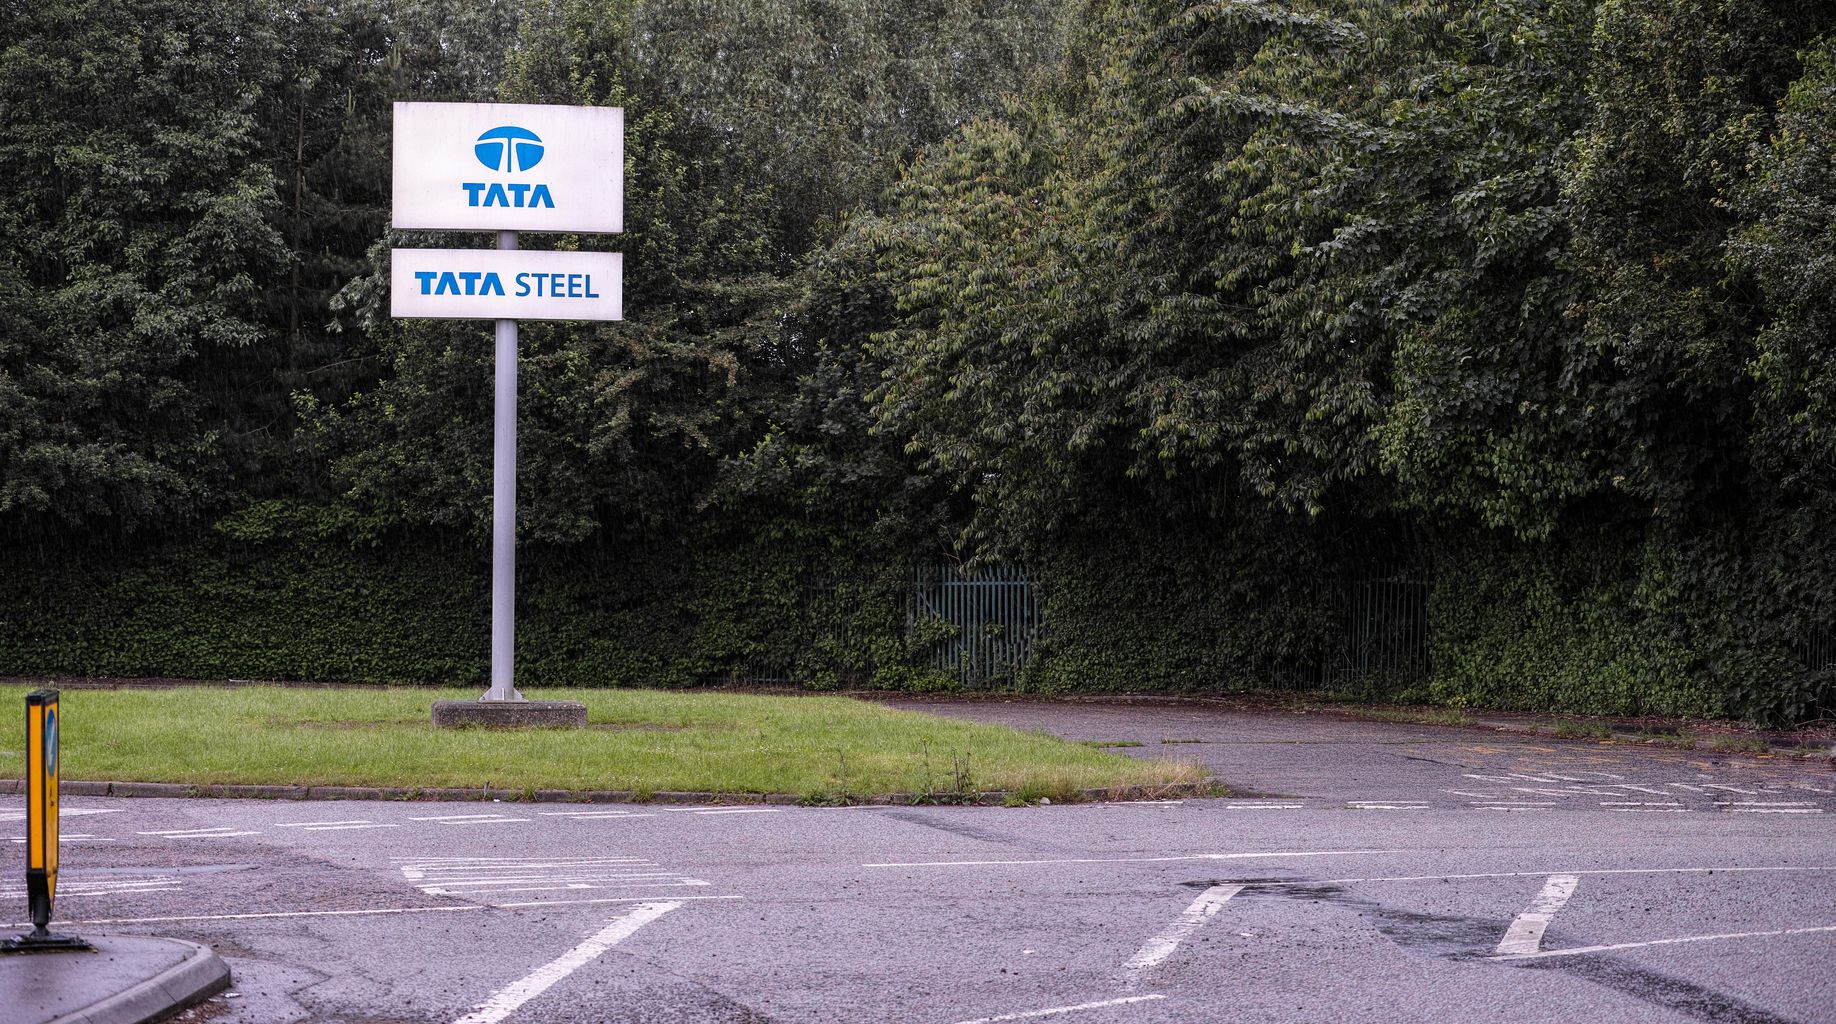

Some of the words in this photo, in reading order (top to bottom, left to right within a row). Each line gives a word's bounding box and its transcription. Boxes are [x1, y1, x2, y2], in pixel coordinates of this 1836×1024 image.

[463, 183, 555, 209] TATA
[415, 272, 505, 296] TATA
[515, 273, 599, 298] STEEL
